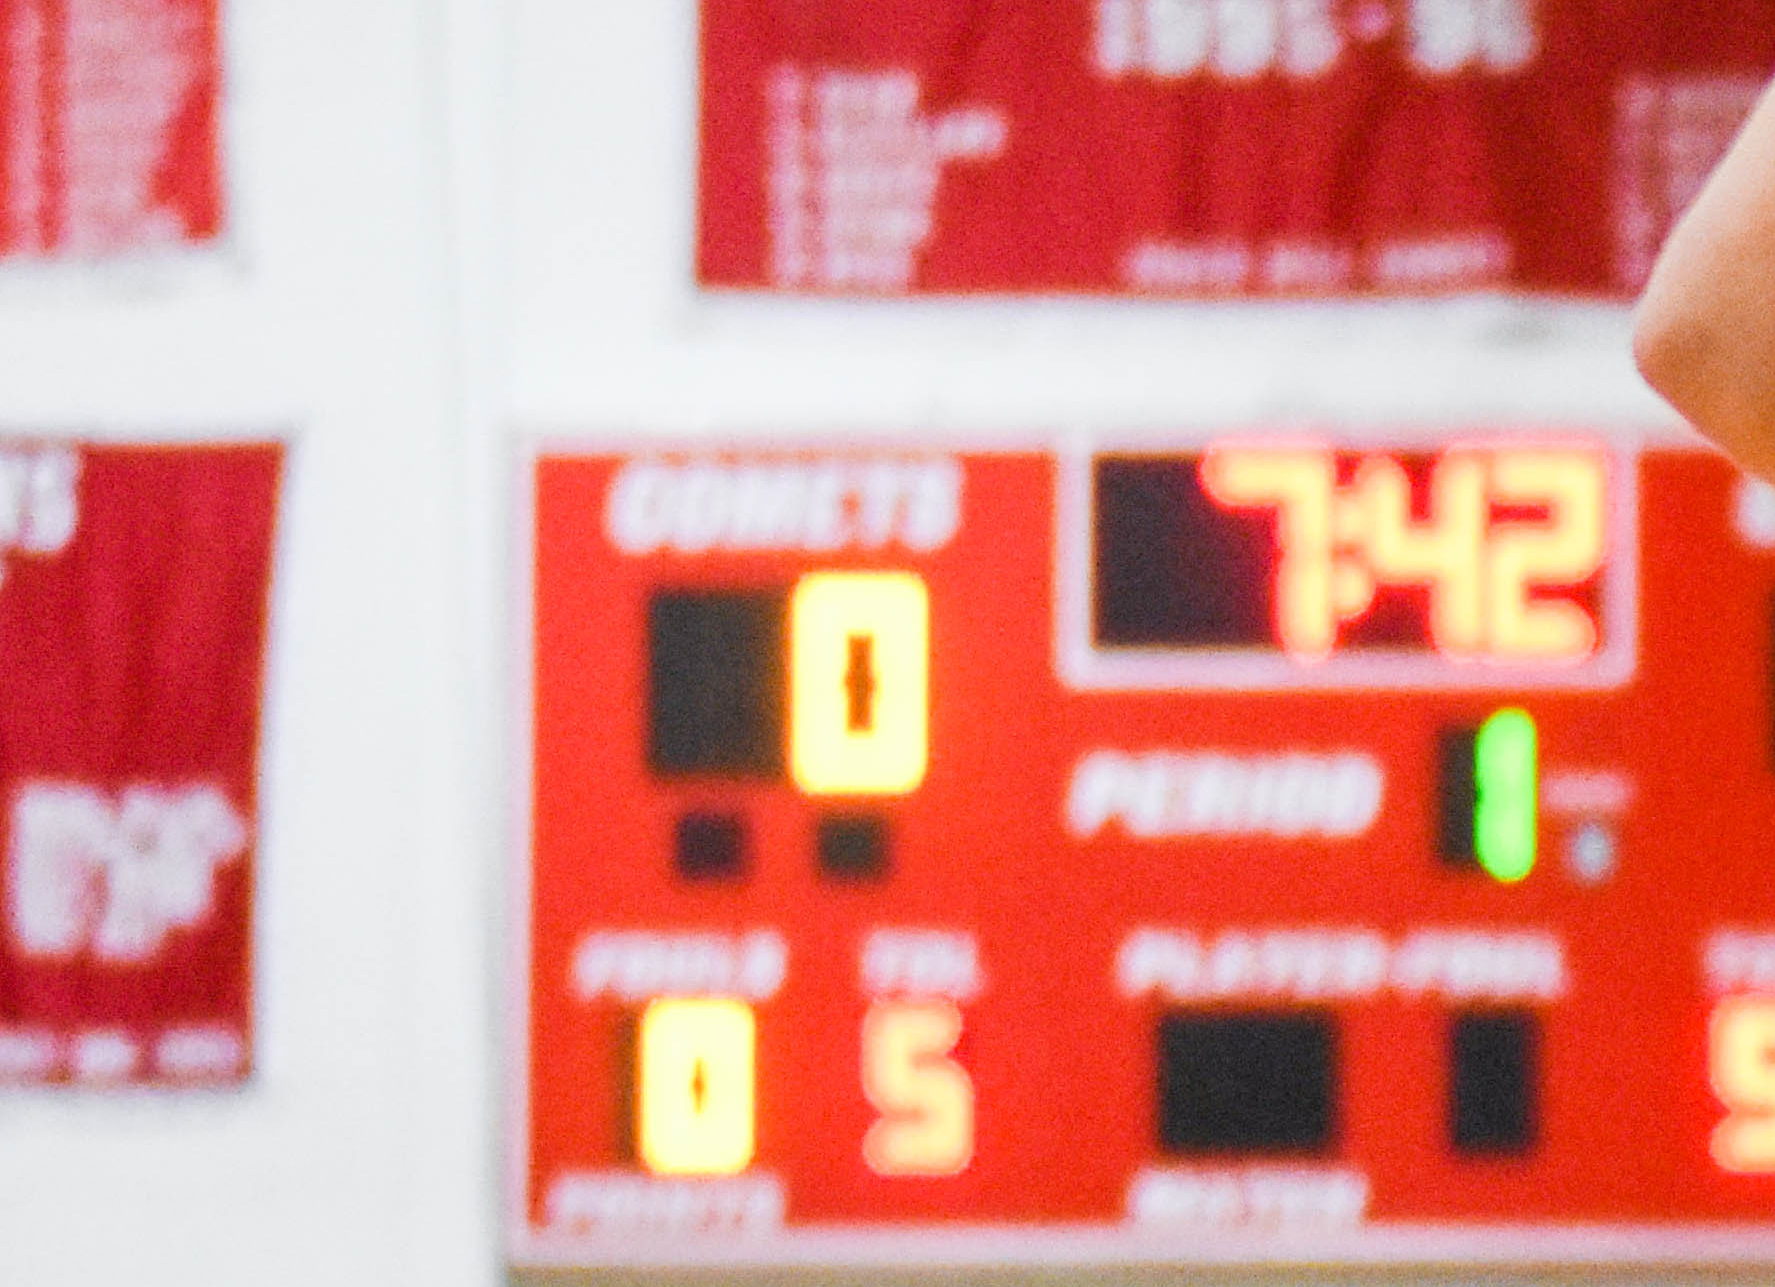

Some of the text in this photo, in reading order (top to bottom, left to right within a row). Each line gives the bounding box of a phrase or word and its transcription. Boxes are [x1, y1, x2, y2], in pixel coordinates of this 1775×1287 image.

[1201, 440, 1606, 665] 7:42
[791, 571, 929, 795] 0
[1066, 751, 1382, 837] PERIOD
[1474, 707, 1537, 883] 1
[638, 996, 755, 1174] 0
[861, 995, 974, 1176] 5
